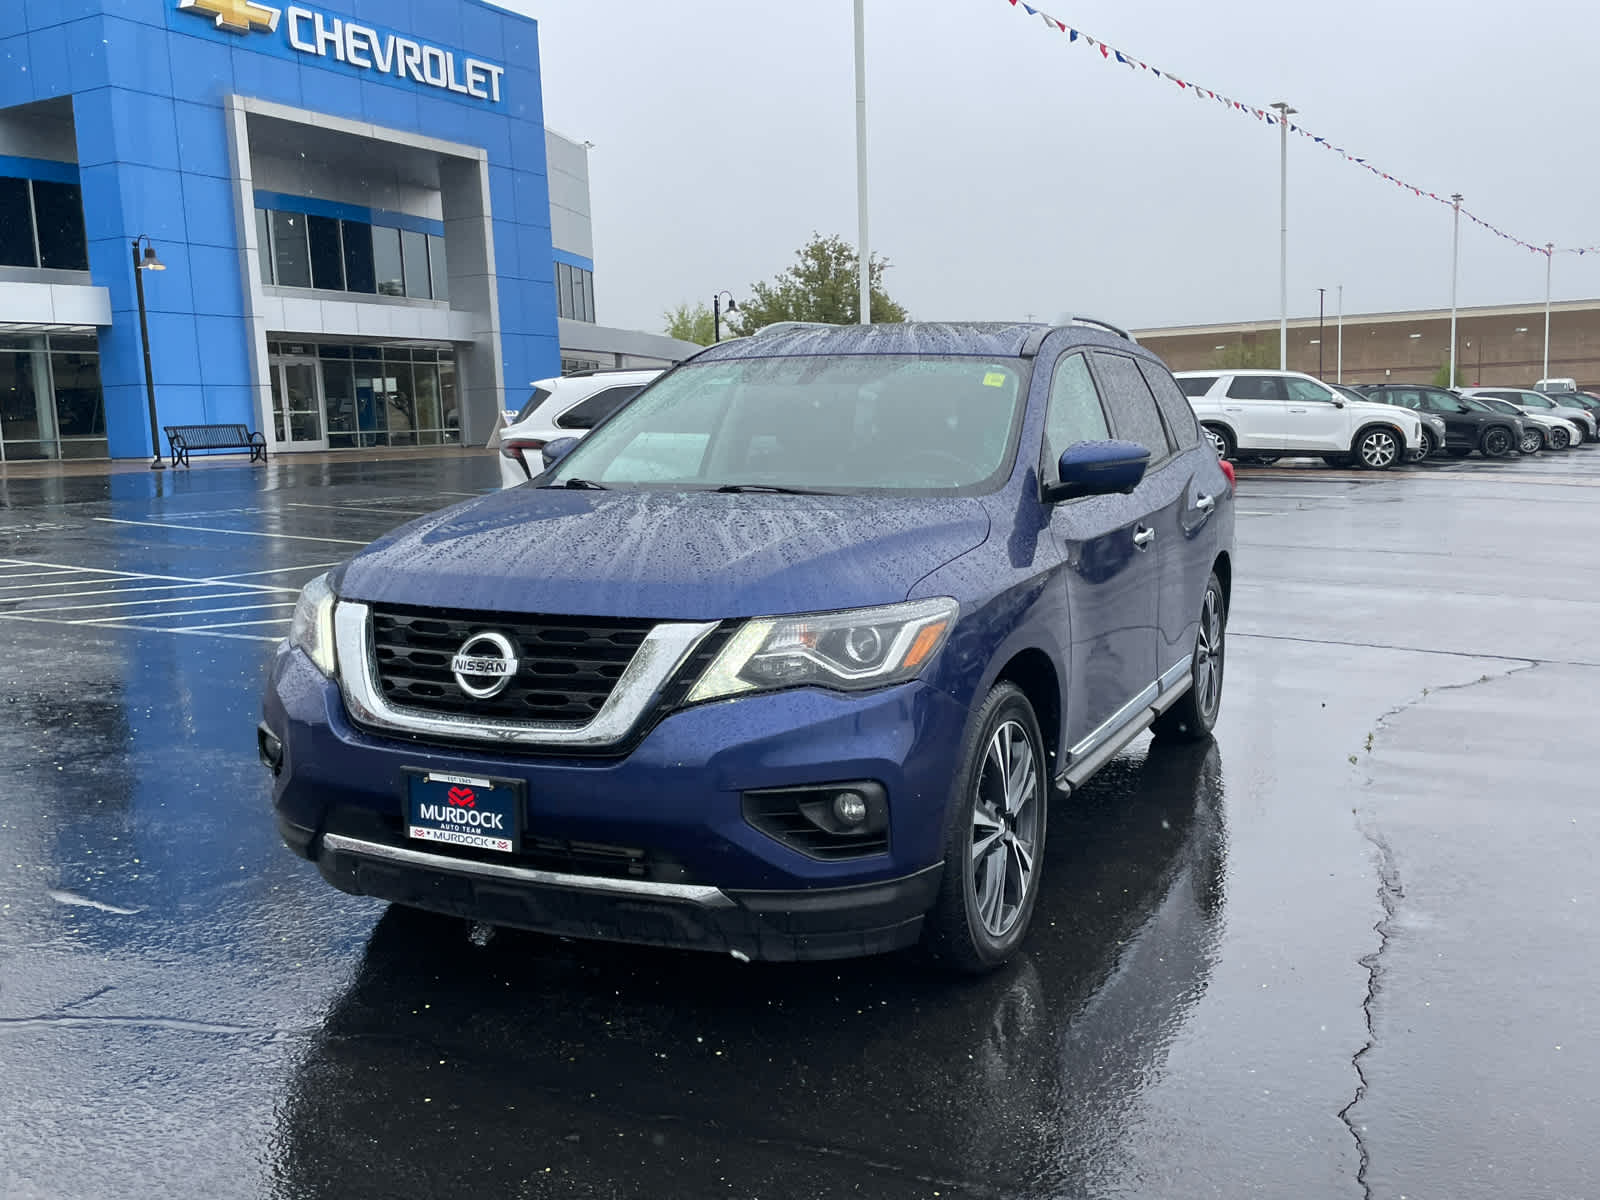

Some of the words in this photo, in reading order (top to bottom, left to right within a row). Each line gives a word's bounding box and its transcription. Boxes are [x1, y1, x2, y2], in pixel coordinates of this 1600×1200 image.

[286, 6, 505, 102] CHEVROLET
[454, 660, 507, 673] NISSAN
[420, 803, 503, 829] MURDOCK
[441, 823, 460, 832] AUTO
[462, 826, 482, 834] TEAM
[433, 831, 489, 846] MURDOCK
